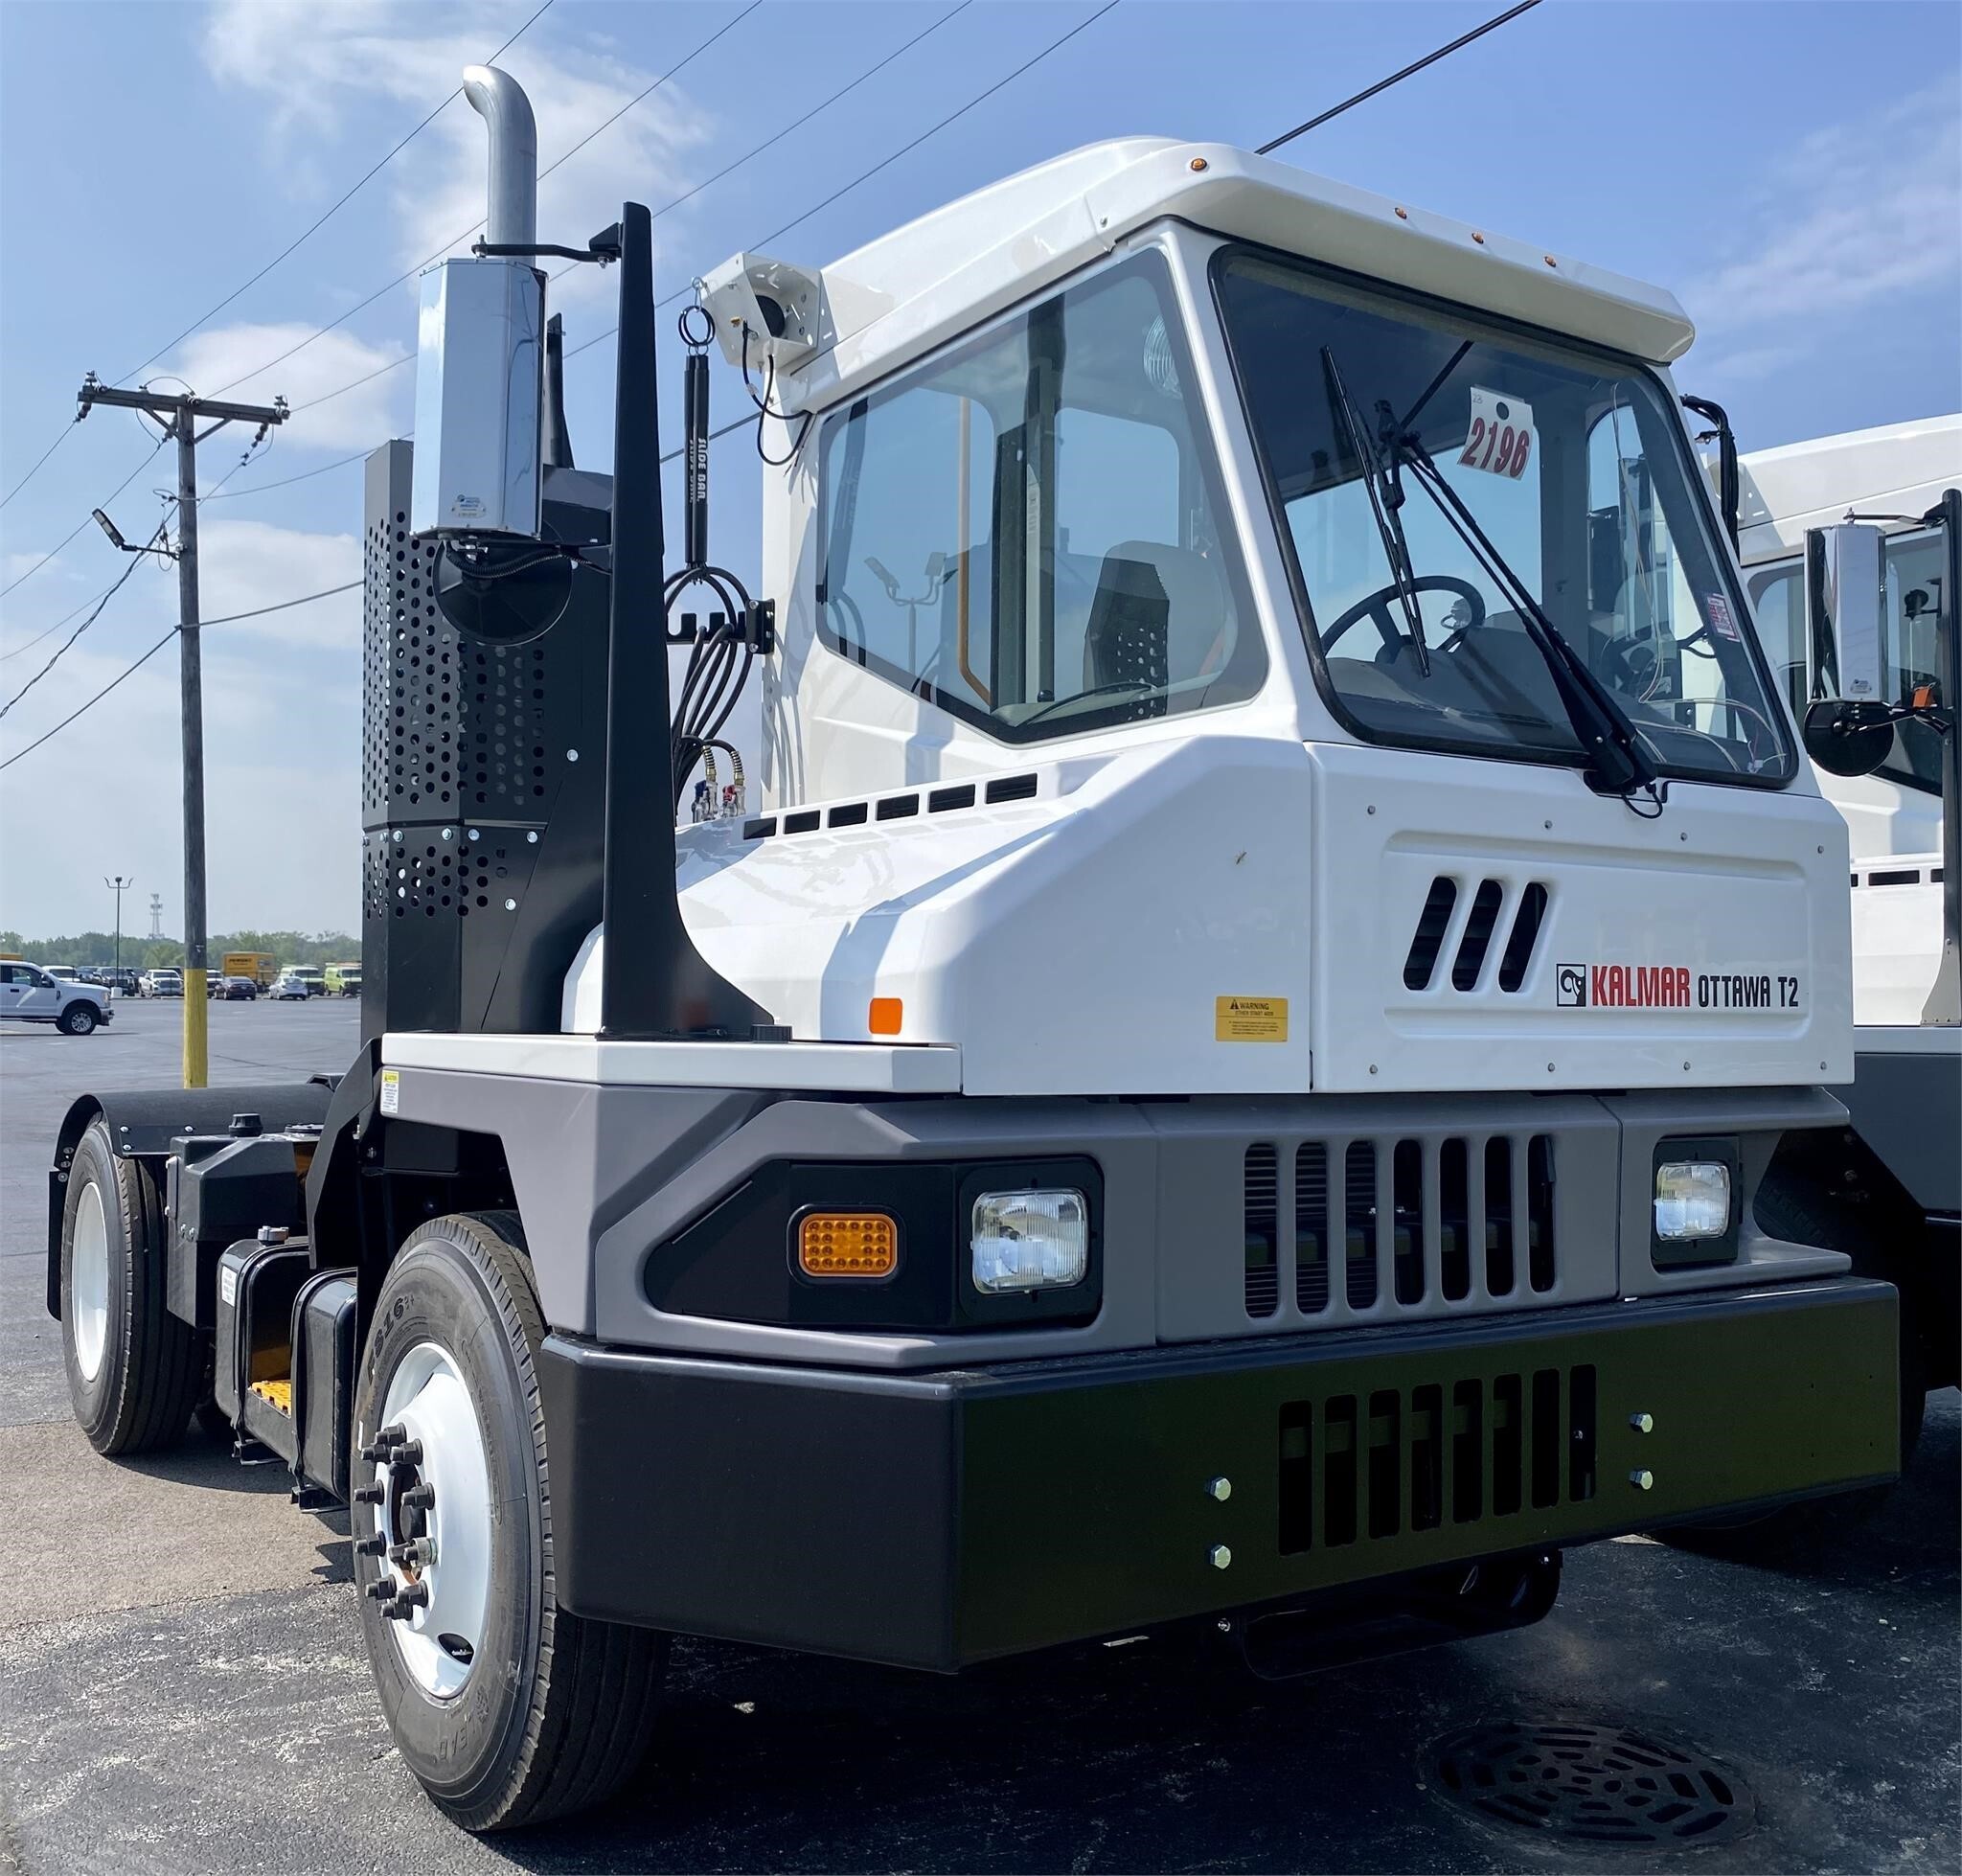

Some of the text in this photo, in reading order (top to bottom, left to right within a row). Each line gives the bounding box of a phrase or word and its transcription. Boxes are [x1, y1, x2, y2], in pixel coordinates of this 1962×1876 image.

[696, 437, 707, 499] SLIDE BAR
[1460, 417, 1530, 478] 2196
[1240, 1002, 1270, 1011] WARNING
[1591, 965, 1799, 1008] KALMAR OTTAWA T2
